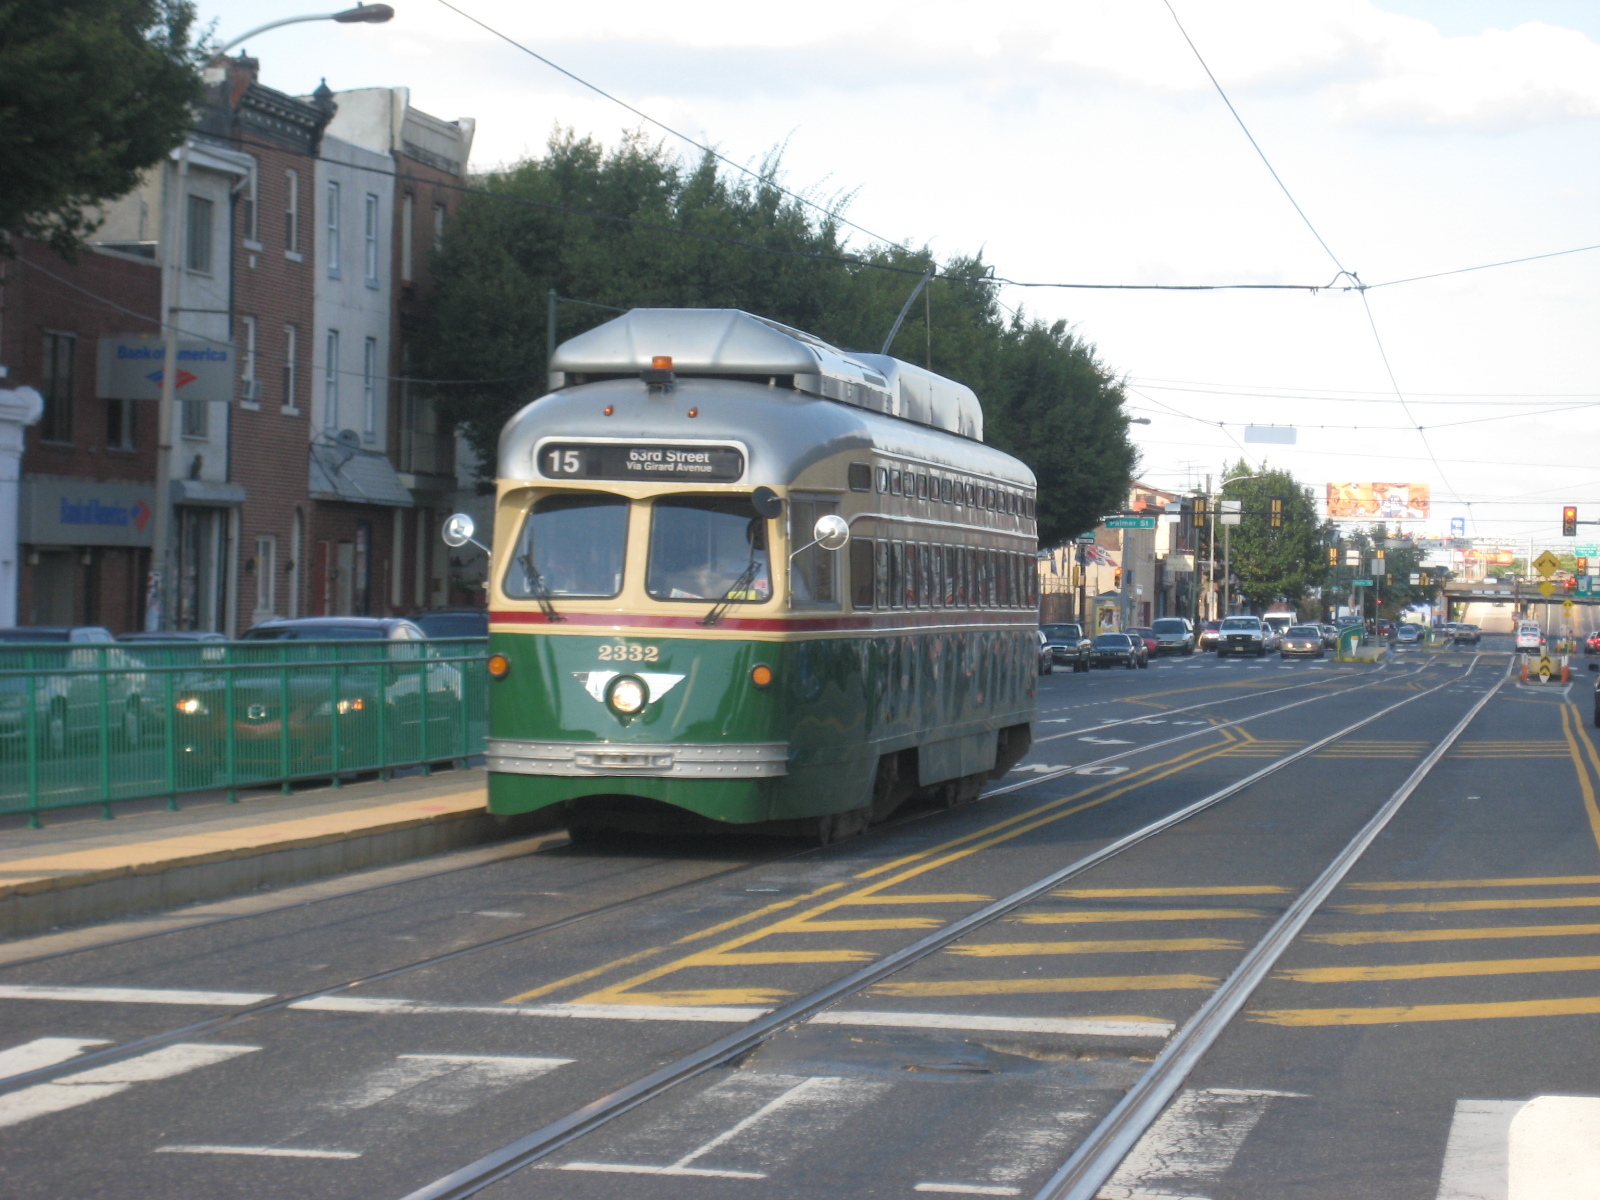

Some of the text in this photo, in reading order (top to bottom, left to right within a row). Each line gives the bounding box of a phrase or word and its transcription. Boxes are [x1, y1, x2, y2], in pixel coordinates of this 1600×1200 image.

[117, 345, 151, 359] Bank
[176, 346, 228, 361] merica
[549, 450, 579, 473] 15
[629, 449, 710, 463] 63rd Street
[626, 461, 713, 473] Via Girard Avenue
[598, 645, 659, 662] 2332
